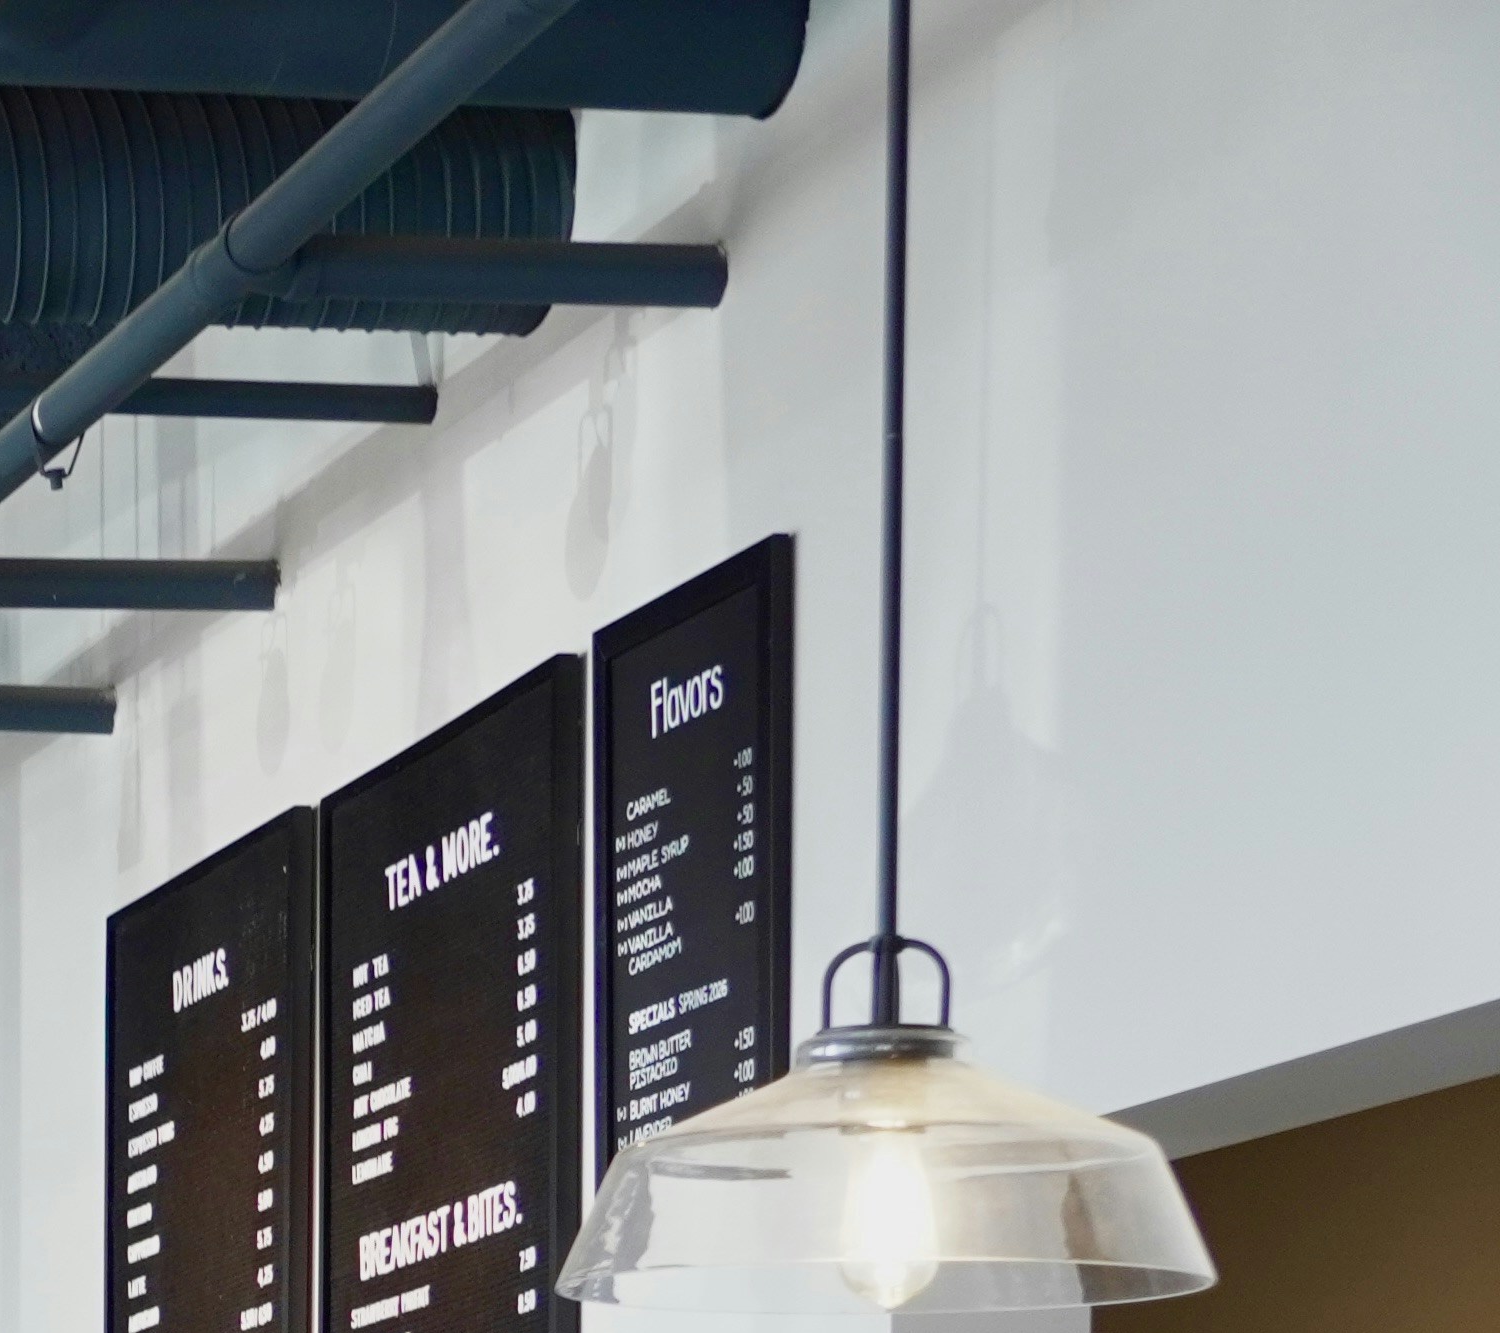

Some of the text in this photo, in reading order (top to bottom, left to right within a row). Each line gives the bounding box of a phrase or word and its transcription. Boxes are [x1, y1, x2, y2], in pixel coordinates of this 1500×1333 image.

[651, 665, 724, 739] Flavors
[626, 788, 671, 821] CARAMEL
[627, 820, 658, 849] HONEY
[385, 812, 500, 911] TEA & MORE.
[628, 849, 659, 878] MAPLE
[661, 835, 689, 863] SYRUP
[628, 875, 662, 903] MOCHA
[628, 896, 673, 928] VANILLA
[628, 921, 673, 954] VANILLA
[629, 937, 682, 975] CARDAMOM
[173, 948, 230, 1013] DRINKS.
[372, 954, 390, 979] TEA
[353, 994, 373, 1021] ICED
[374, 985, 391, 1012] TEA
[629, 997, 676, 1035] SPECIALS
[678, 985, 707, 1014] SPRING
[353, 1021, 386, 1055] MATCHA
[629, 1029, 692, 1071] BROWN BUTTER
[629, 1057, 678, 1091] PISTACHIO
[629, 1092, 658, 1121] BURNT
[660, 1081, 690, 1109] HONEY
[359, 1181, 524, 1281] BREAKFAST & BITES.
